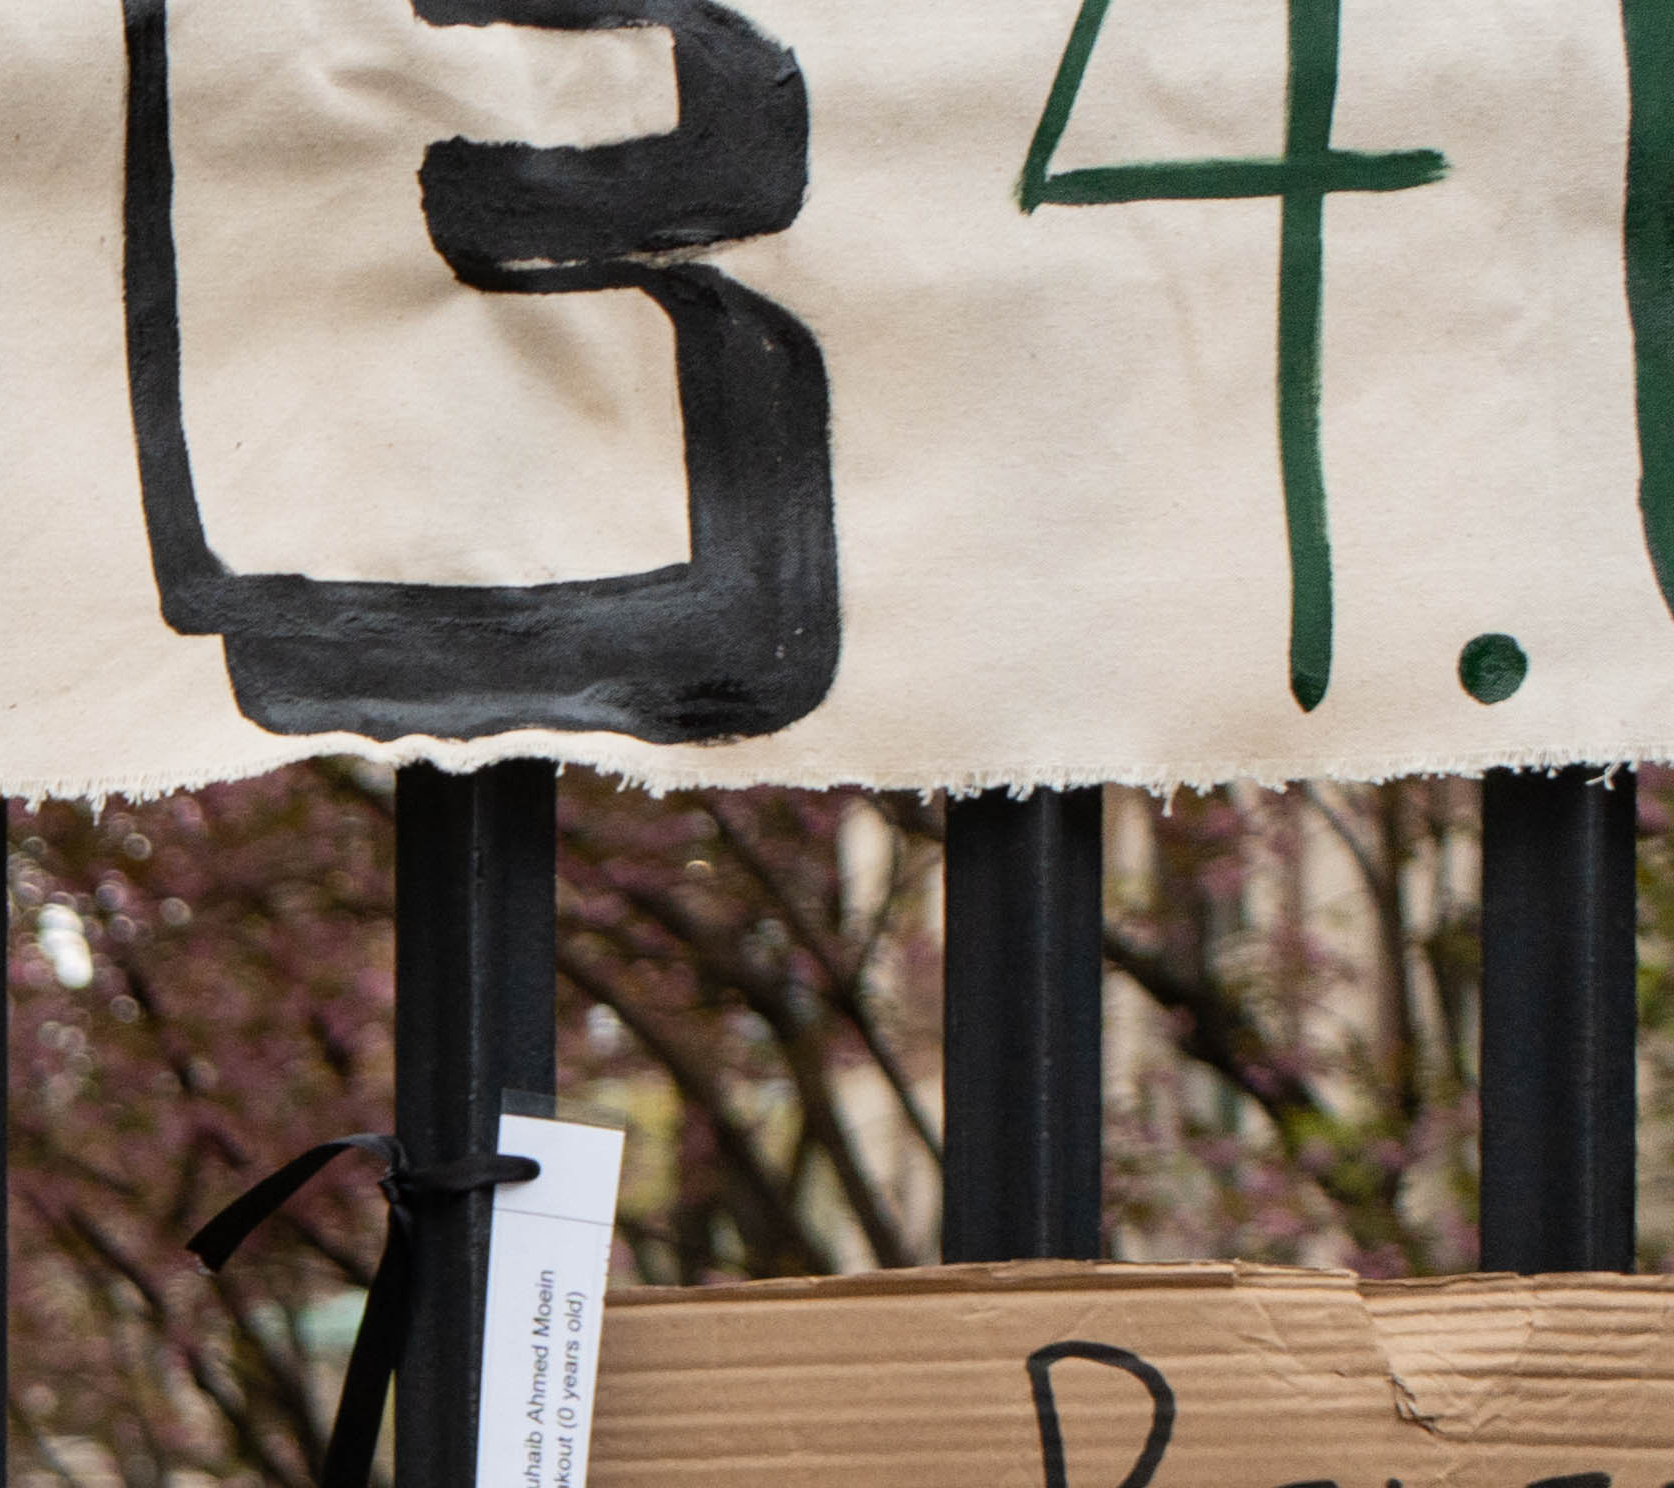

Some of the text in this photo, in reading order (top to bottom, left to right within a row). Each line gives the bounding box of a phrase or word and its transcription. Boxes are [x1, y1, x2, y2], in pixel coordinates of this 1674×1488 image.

[535, 1270, 555, 1337] Moein
[566, 1291, 585, 1333] old)
[525, 1345, 549, 1421] Ahmed
[560, 1340, 582, 1400] years
[556, 1407, 577, 1429] (0
